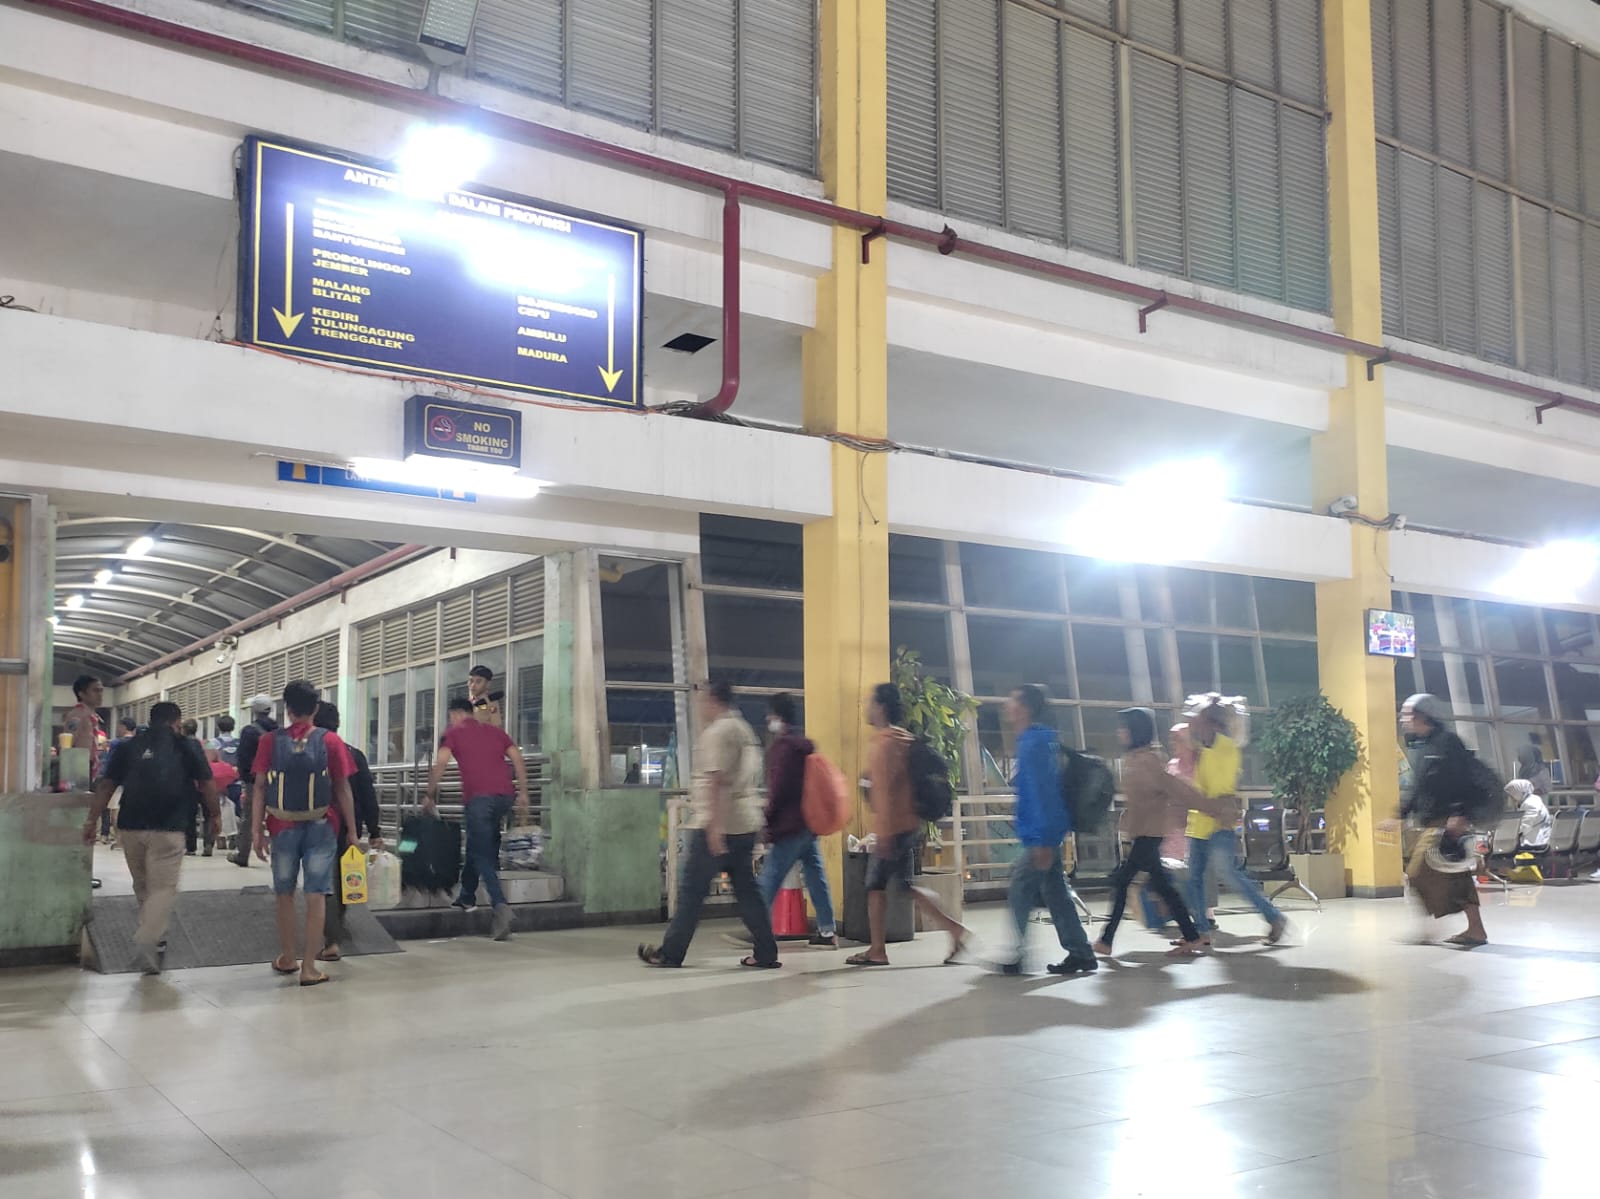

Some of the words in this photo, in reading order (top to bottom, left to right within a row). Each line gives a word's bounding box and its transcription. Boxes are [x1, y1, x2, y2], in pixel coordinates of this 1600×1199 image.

[448, 193, 501, 216] DALAM
[503, 206, 571, 233] PROVINSI
[312, 248, 412, 276] PROBOLINGGO
[312, 259, 369, 277] JEMBER
[312, 277, 371, 295] MALANG
[312, 287, 361, 304] BLITAR
[312, 306, 359, 322] KEDIRI
[311, 316, 415, 342] TULUNGAGUNG
[311, 326, 403, 350] TRENGGALEK
[517, 326, 567, 343] AMBULU
[517, 346, 568, 364] MADURA
[473, 421, 491, 433] NO
[456, 432, 509, 448] SMOKING
